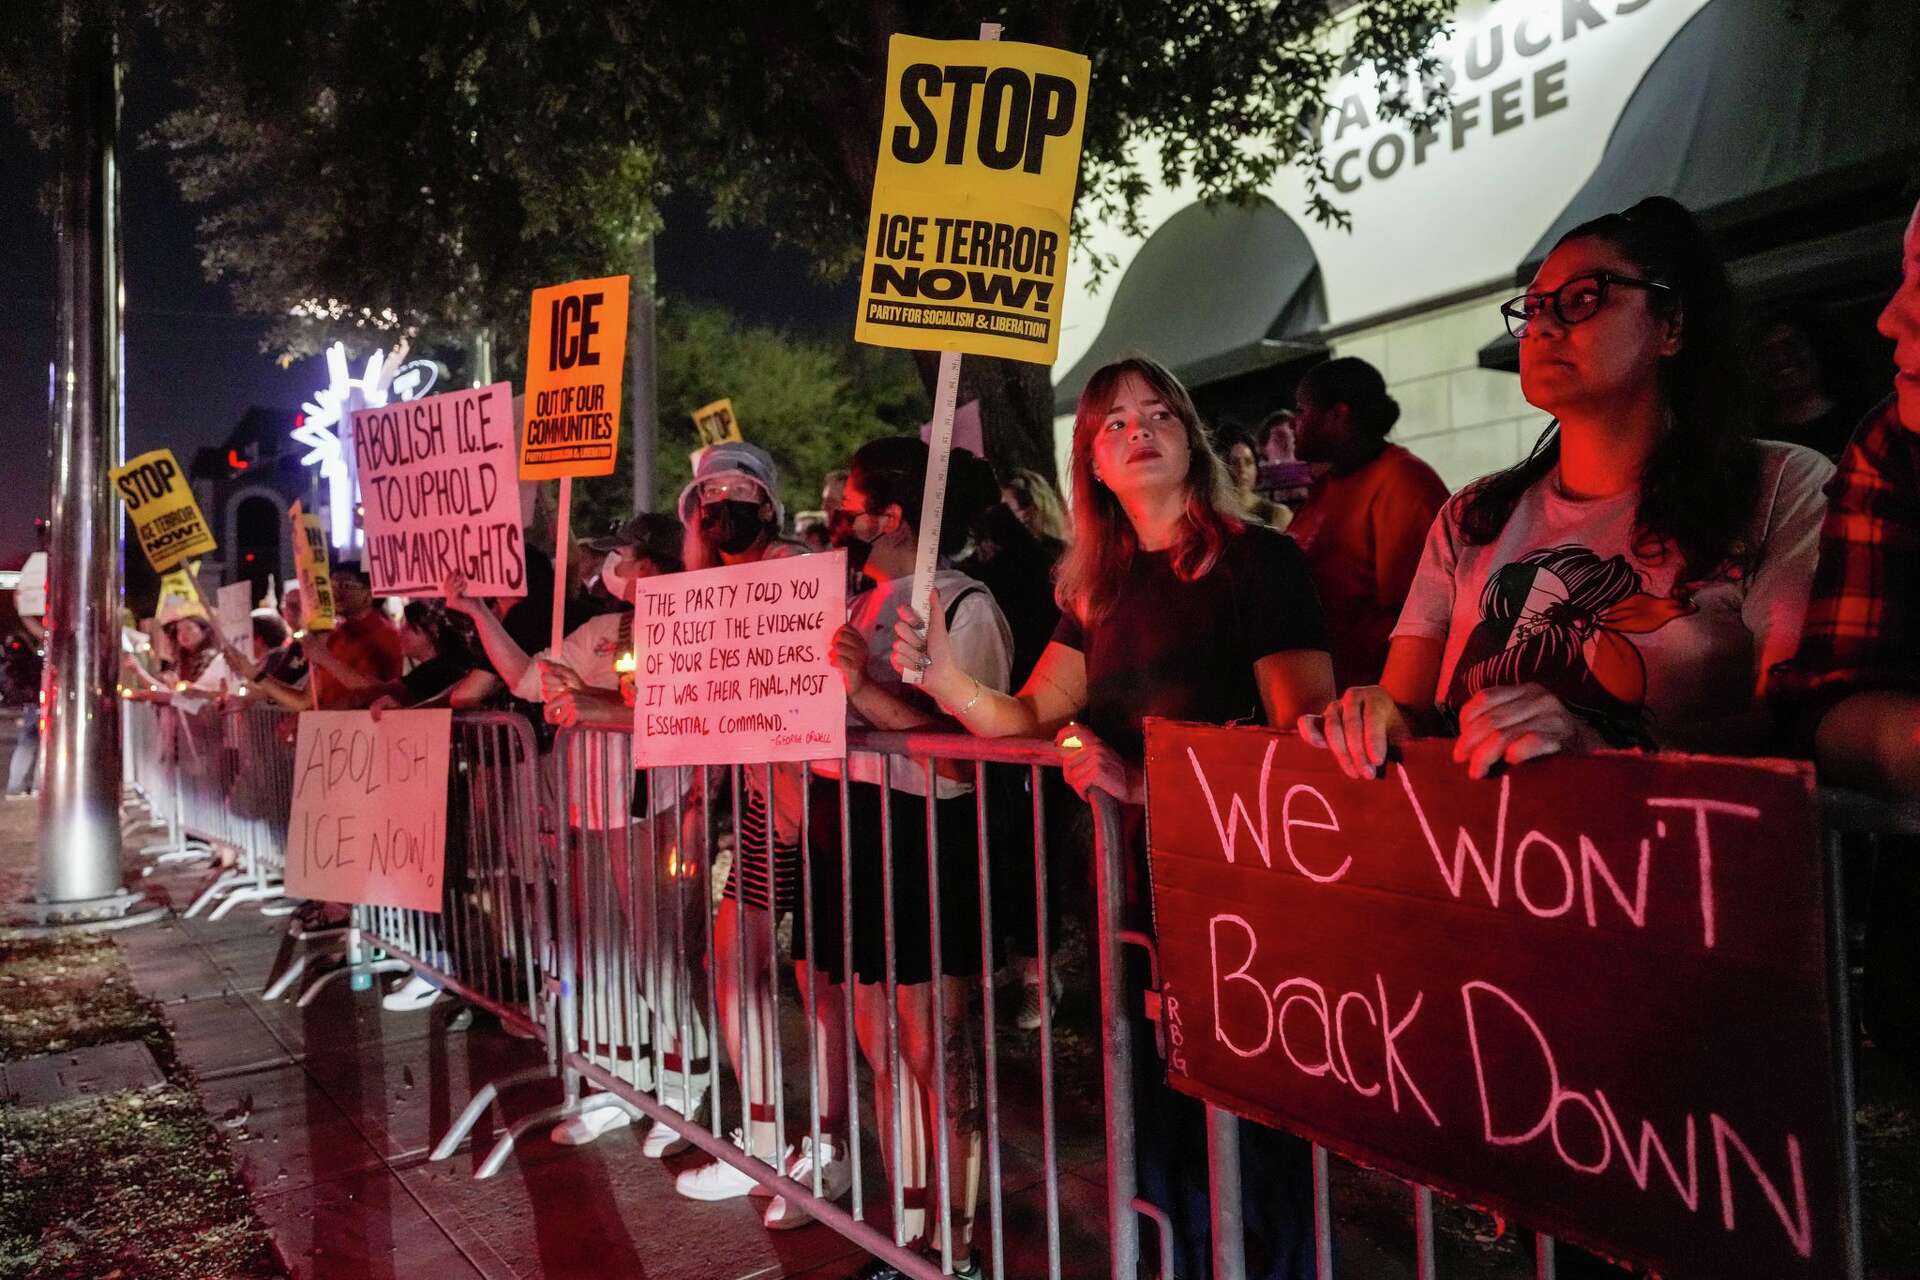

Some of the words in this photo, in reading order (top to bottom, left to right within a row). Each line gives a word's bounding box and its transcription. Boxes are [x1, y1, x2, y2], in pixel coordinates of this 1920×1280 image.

[892, 63, 1077, 174] STOP
[1333, 60, 1568, 194] COFFEE
[875, 213, 929, 262] ICE
[935, 218, 1058, 277] TERROR
[871, 263, 1054, 313] NOW!
[549, 292, 604, 371] ICE
[869, 304, 901, 320] PARTY
[902, 306, 922, 323] FOR
[922, 309, 975, 327] SOCIALISM
[975, 315, 989, 329] &
[990, 315, 1047, 338] LIBERATION
[537, 390, 559, 417] OUT
[561, 387, 575, 414] OF
[576, 384, 605, 412] OUR
[356, 402, 446, 472] ABOLISH
[528, 412, 612, 445] COMMUNITIES
[118, 459, 176, 510] STOP
[147, 522, 202, 552] NOW!
[685, 584, 738, 614] PARTY
[746, 582, 782, 604] TOLD
[790, 577, 819, 600] YOU
[646, 622, 665, 648] TO
[672, 620, 717, 646] REJECT
[725, 617, 751, 639] THE
[757, 611, 824, 636] EVIDENCE
[646, 653, 664, 675] OF
[669, 651, 703, 674] YOUR
[709, 647, 740, 670] EYES
[746, 647, 774, 667] AND
[778, 645, 821, 663] EARS.
[645, 684, 666, 707] IT
[674, 684, 698, 705] WAS
[706, 680, 741, 702] THEIR
[789, 673, 829, 696] MOST
[647, 714, 709, 737] ESSENTIAL
[297, 728, 429, 799] ABOLISH
[1187, 738, 1353, 884] We
[303, 811, 356, 878] ICE
[369, 810, 437, 888] NOW!
